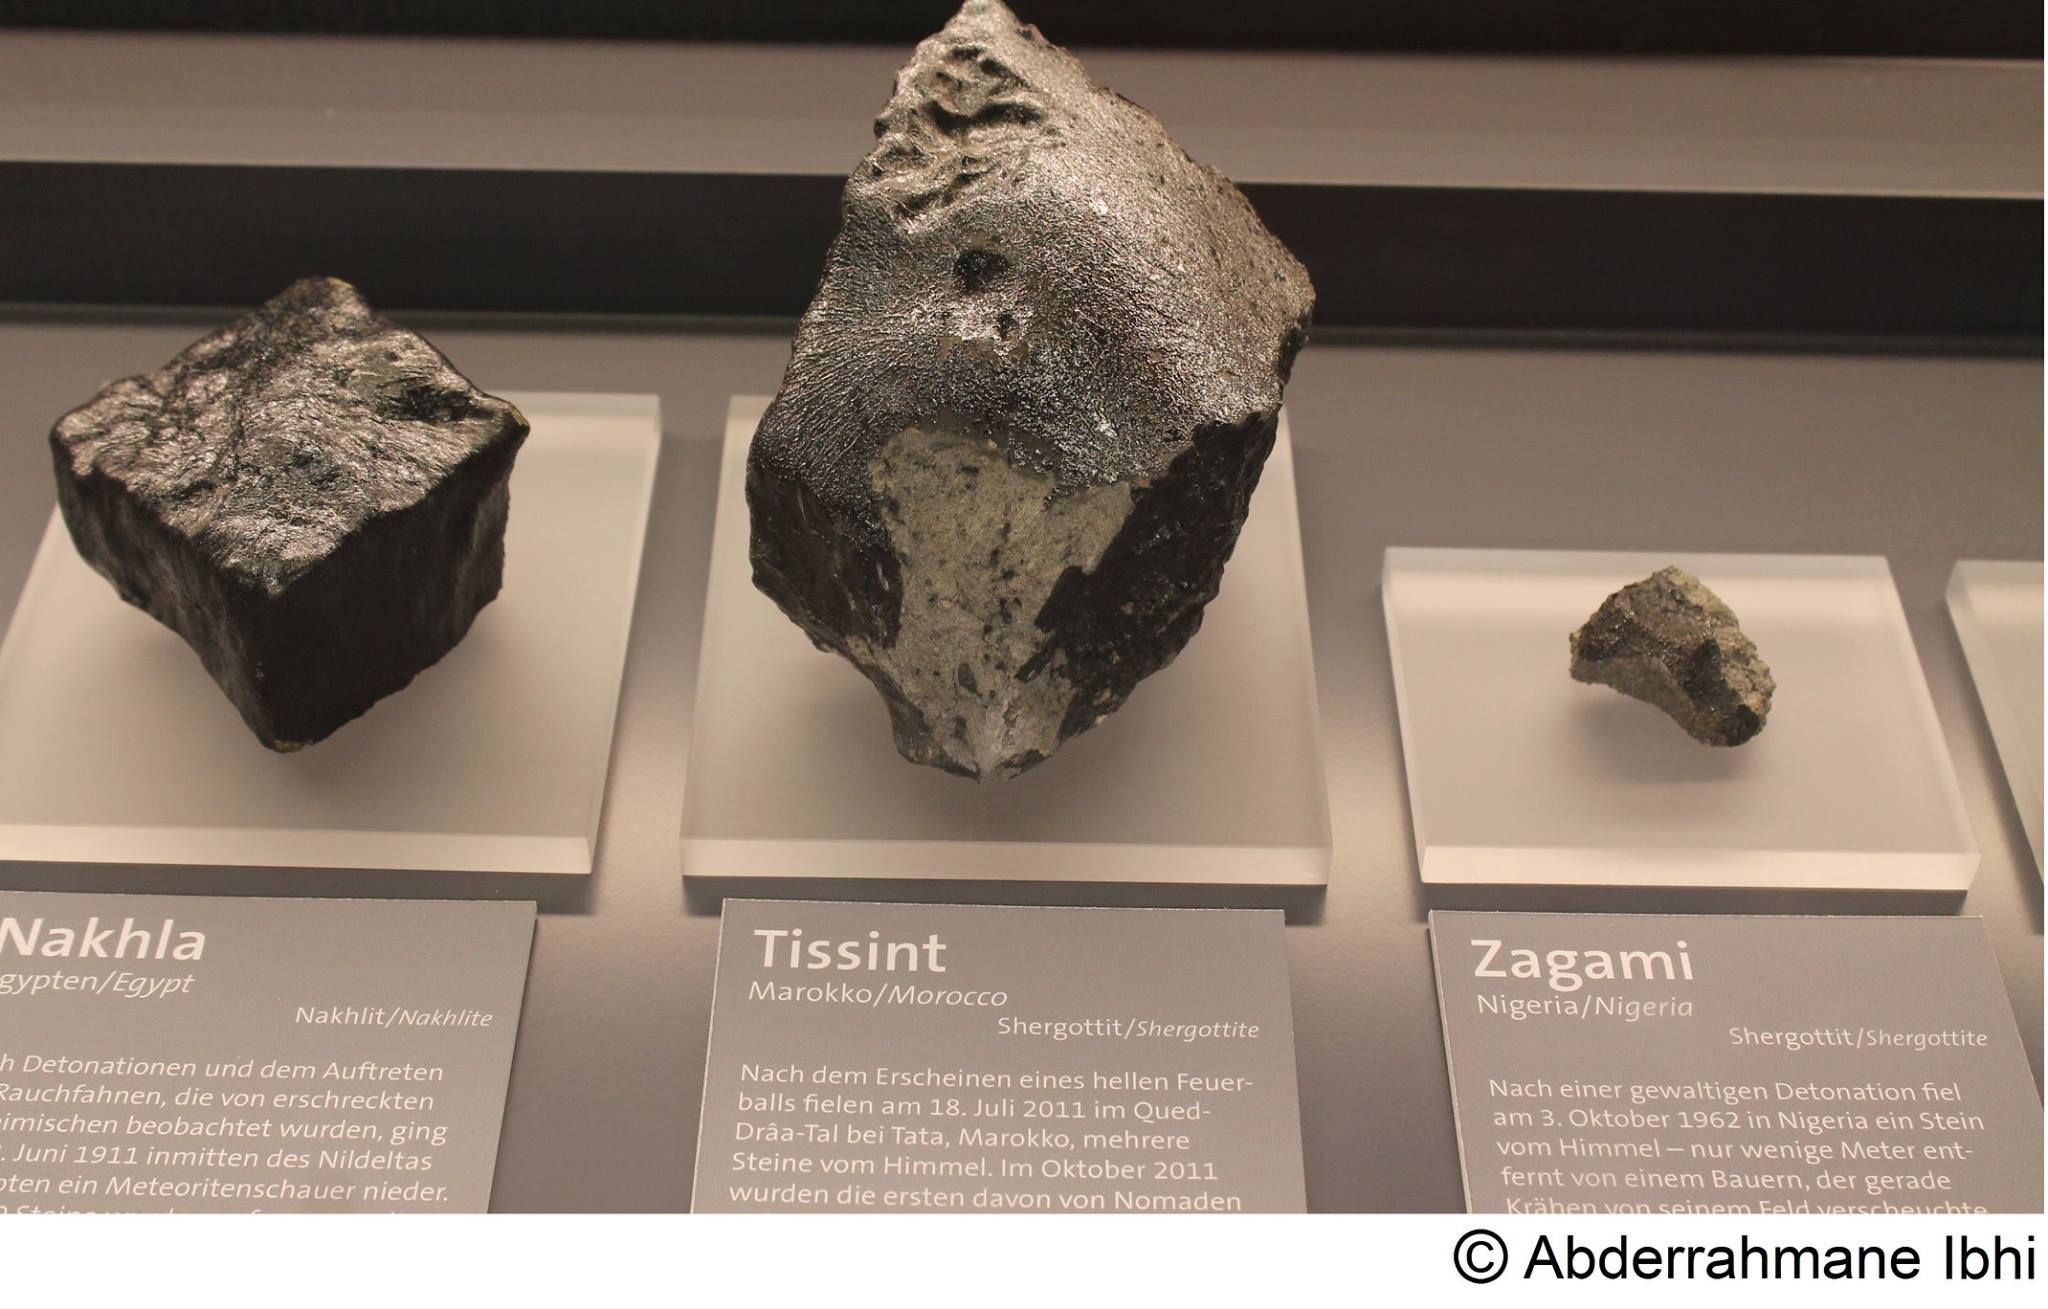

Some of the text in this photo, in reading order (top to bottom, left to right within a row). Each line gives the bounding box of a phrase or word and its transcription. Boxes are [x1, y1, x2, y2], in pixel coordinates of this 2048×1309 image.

[0, 916, 206, 961] Nakhla
[753, 927, 947, 973] Tissint
[1470, 938, 1694, 993] Zagami
[0, 970, 196, 999] gypten/Egypt
[748, 980, 1008, 1008] Marokko/Morocco
[295, 1005, 494, 1029] Nakhlit/Nakhlite
[1477, 994, 1693, 1023] Nigeria/Nigeria
[997, 1016, 1260, 1043] Shergottit/Shergottite
[1728, 1026, 1988, 1052] Shergottit/Shergottite
[22, 1054, 197, 1077] Detonationen
[205, 1058, 255, 1078] und
[260, 1059, 316, 1080] dem
[321, 1061, 444, 1081] Auftreten
[741, 1063, 1254, 1092] Nach dem Erscheinen eines hellen Feuer-
[174, 1087, 214, 1107] die
[221, 1092, 265, 1107] von
[273, 1089, 434, 1111] erschreckten
[1489, 1078, 1962, 1106] Nach einer gewaltigen Detonation fiel
[738, 1091, 1211, 1124] balls fielen am 18. Juli 2011 im Qued-
[0, 1112, 449, 1147] imischen beobachtet wurden, ging
[735, 1121, 1190, 1151] Drâa-Tal bei Tata, Marokko, mehrere
[1493, 1108, 1985, 1136] am 3. Oktober 1962 in Nigeria ein Stein
[11, 1143, 68, 1163] Juni
[73, 1145, 138, 1165] 1911
[146, 1145, 259, 1168] inmitten
[266, 1148, 311, 1169] des
[318, 1149, 433, 1171] Nildeltas
[1496, 1141, 1552, 1156] vom
[1559, 1137, 1661, 1158] Himmel
[1690, 1143, 1733, 1159] nur
[1739, 1140, 1834, 1165] wenige
[1840, 1140, 1916, 1160] Meter
[1923, 1141, 1974, 1160] ent-
[731, 1151, 1219, 1180] Steine vom Himmel. Im Oktober 2011
[58, 1174, 98, 1195] ein
[104, 1176, 357, 1200] Meteoritenschauer
[362, 1180, 448, 1202] nieder.
[1499, 1165, 1953, 1196] fernt von einem Bauern, der gerade
[729, 1183, 1241, 1211] wurden die ersten davon von Nomaden
